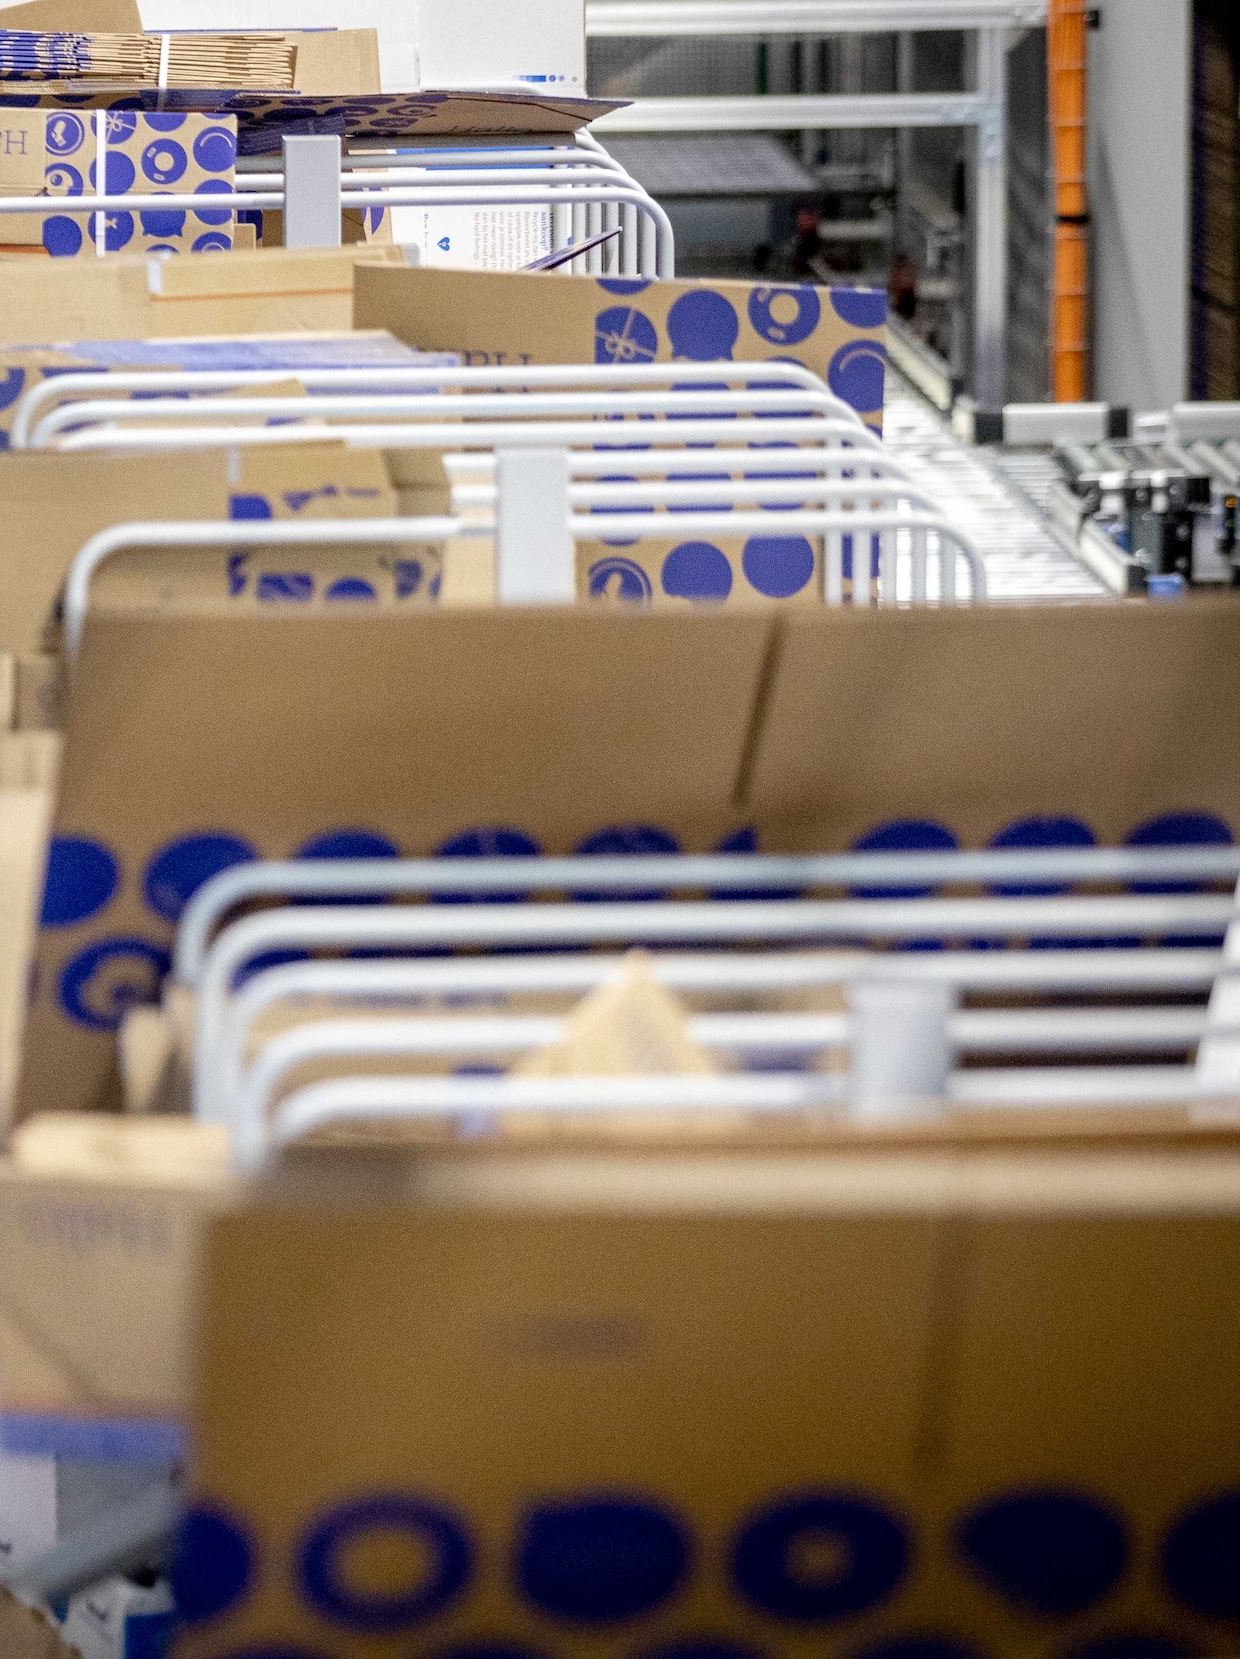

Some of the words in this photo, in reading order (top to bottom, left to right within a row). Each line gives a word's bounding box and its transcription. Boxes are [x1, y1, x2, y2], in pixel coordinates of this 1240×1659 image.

[474, 212, 480, 221] No
[523, 211, 531, 249] Bijvoorbeeld
[531, 234, 539, 244] mij
[540, 211, 548, 251] aankoop?
